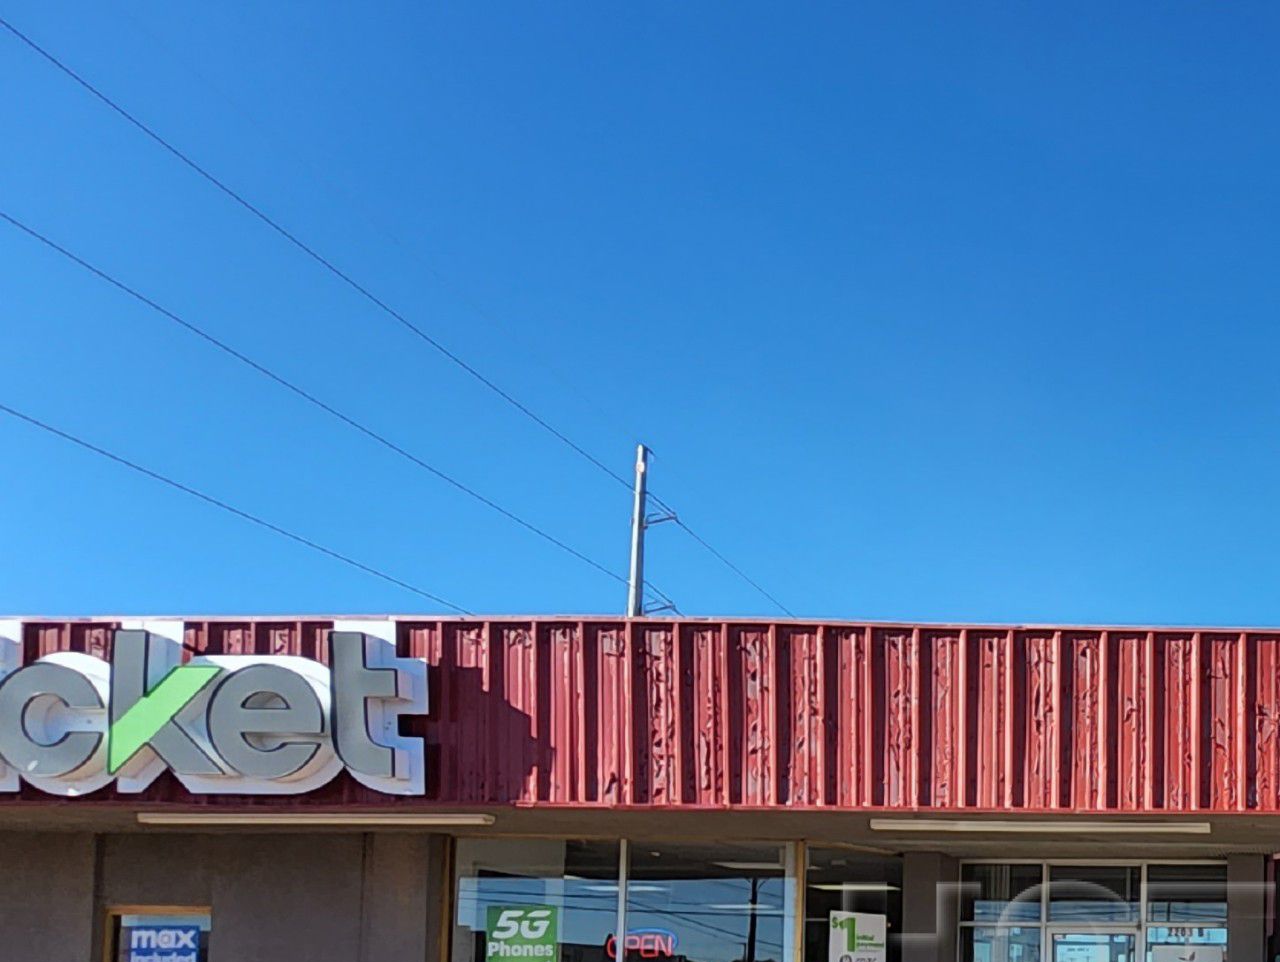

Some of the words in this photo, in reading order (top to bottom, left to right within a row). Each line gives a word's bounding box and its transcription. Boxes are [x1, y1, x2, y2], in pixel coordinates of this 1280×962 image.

[0, 629, 400, 780] cket
[492, 910, 552, 939] 5G
[131, 929, 196, 949] max
[487, 941, 554, 957] Phones
